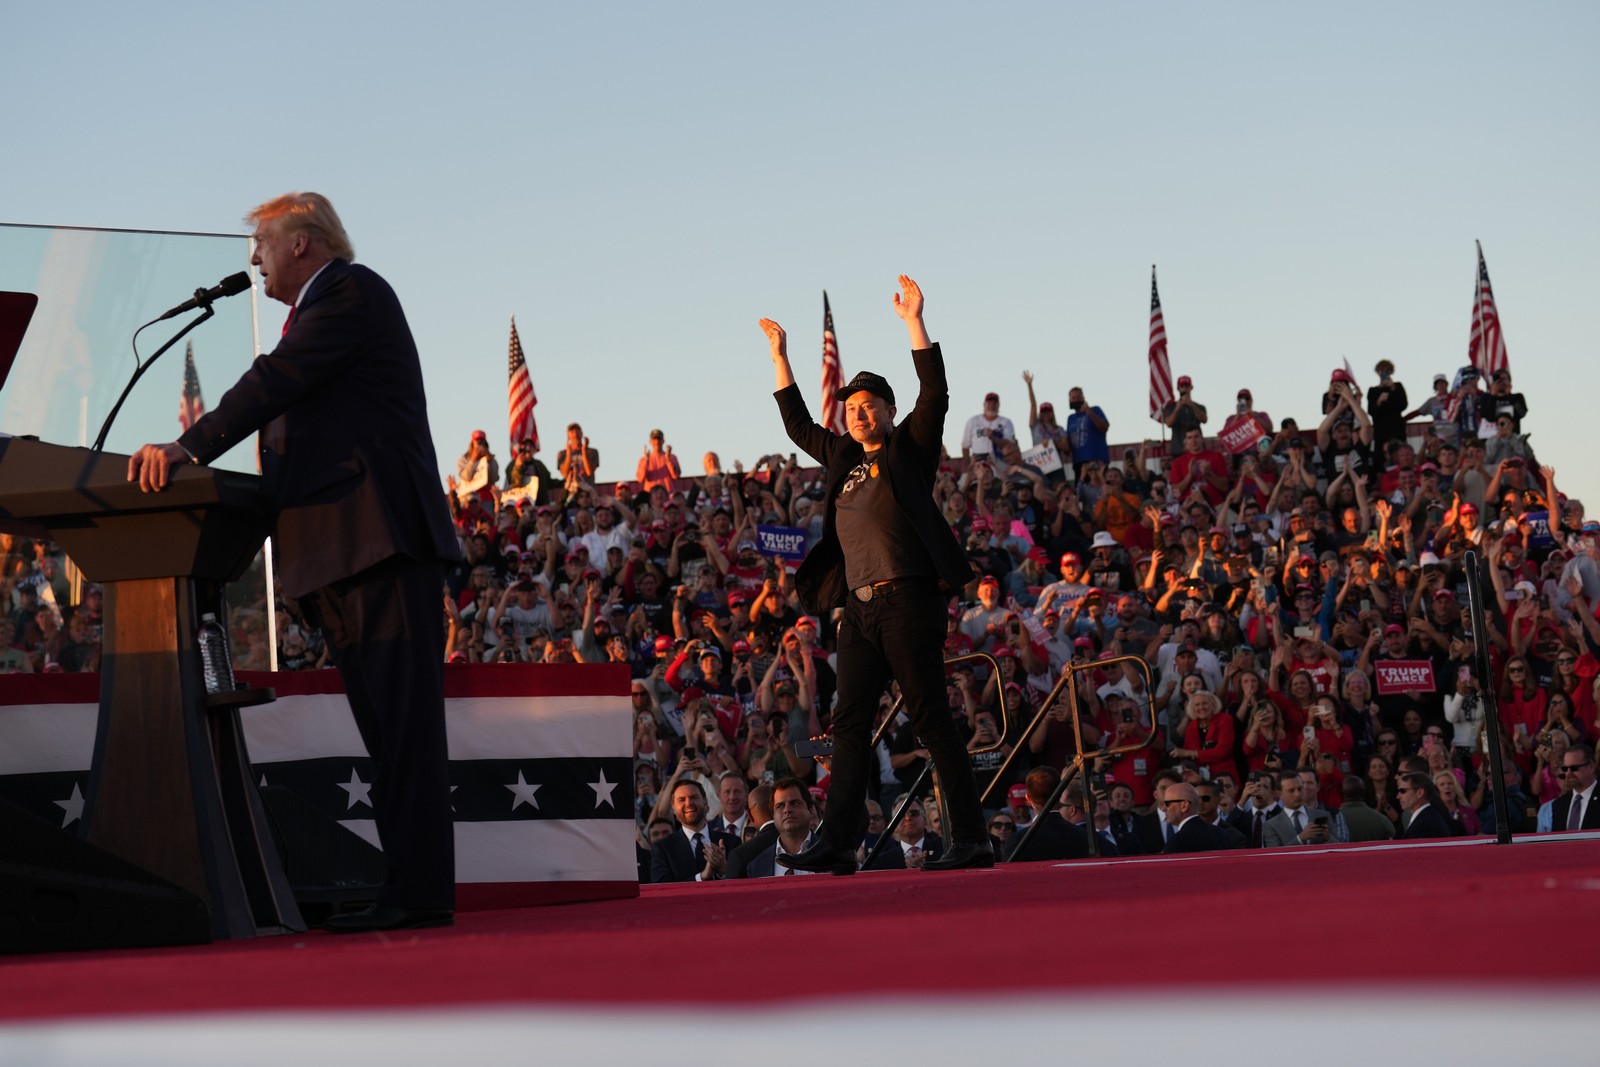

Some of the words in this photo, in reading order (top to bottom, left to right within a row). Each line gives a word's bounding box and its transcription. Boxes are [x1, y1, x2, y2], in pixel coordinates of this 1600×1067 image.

[1222, 418, 1256, 445] TRUMP
[759, 531, 805, 544] TRUMP
[764, 540, 799, 552] VANCE
[1378, 667, 1430, 678] TRUMP
[1385, 674, 1426, 684] VANCE
[971, 751, 1002, 762] TRUMP
